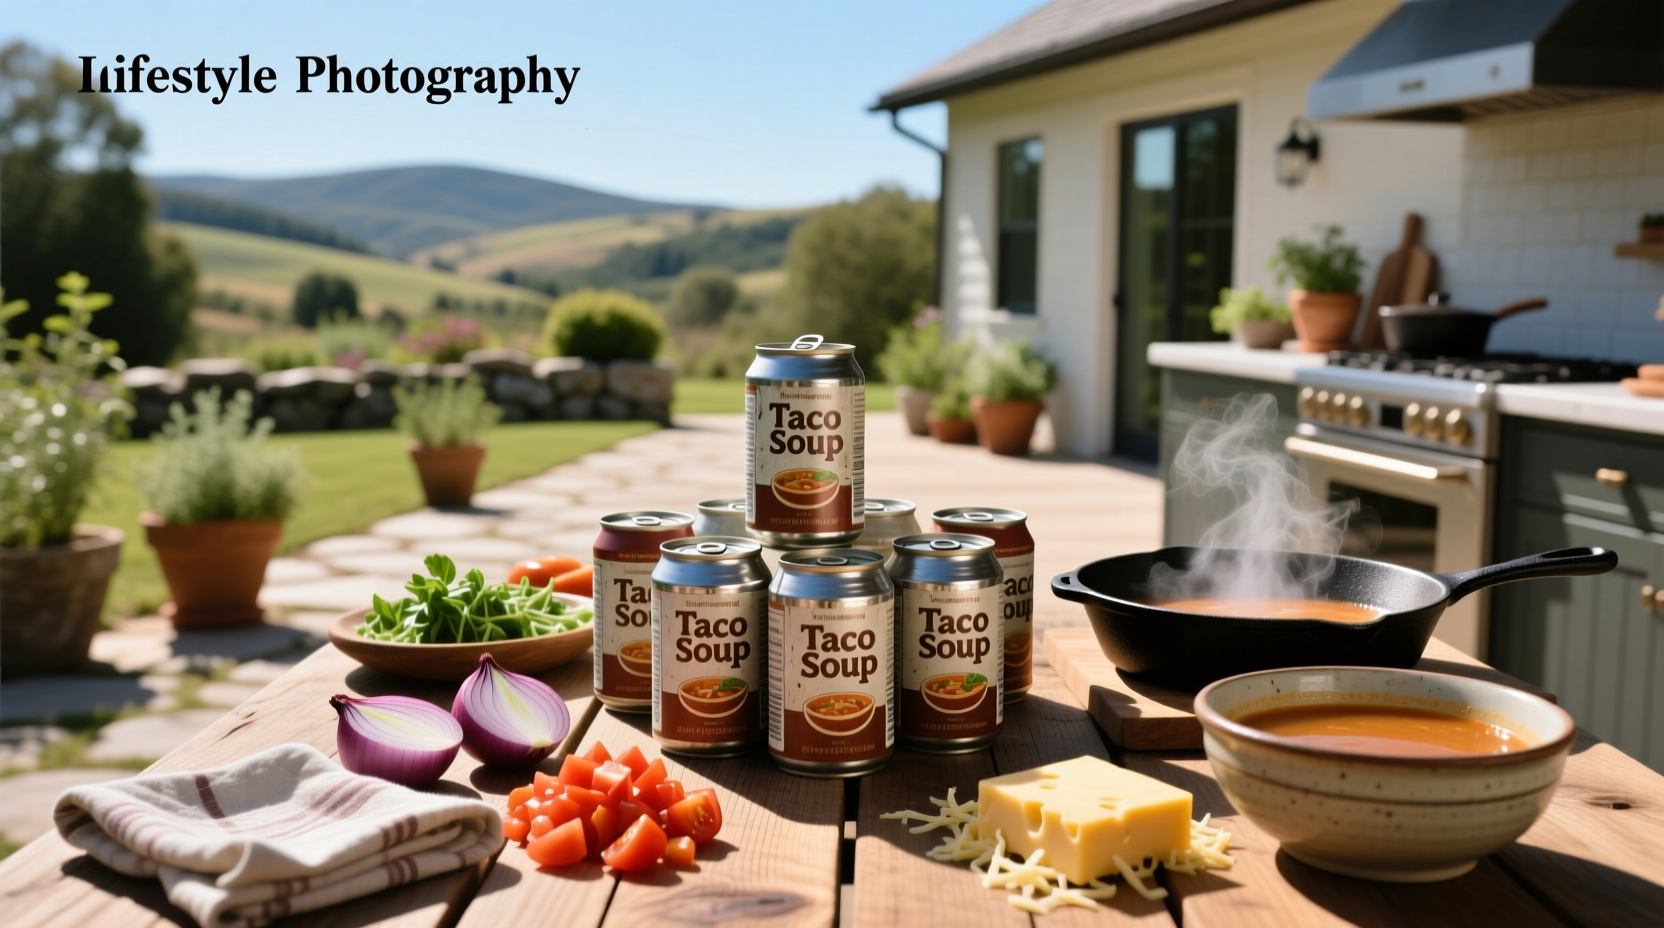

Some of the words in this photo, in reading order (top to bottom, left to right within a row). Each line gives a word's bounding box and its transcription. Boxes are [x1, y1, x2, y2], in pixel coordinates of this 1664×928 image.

[769, 403, 841, 430] Taco
[769, 430, 844, 462] Soup
[614, 578, 652, 604] Ta
[1004, 575, 1033, 597] aco
[615, 603, 652, 628] So
[918, 607, 989, 634] Taco
[1004, 598, 1033, 622] oup
[675, 610, 748, 638] Taco
[800, 624, 876, 653] Taco
[918, 634, 991, 665] Soup
[675, 637, 751, 669] Soup
[800, 652, 878, 684] Soup
